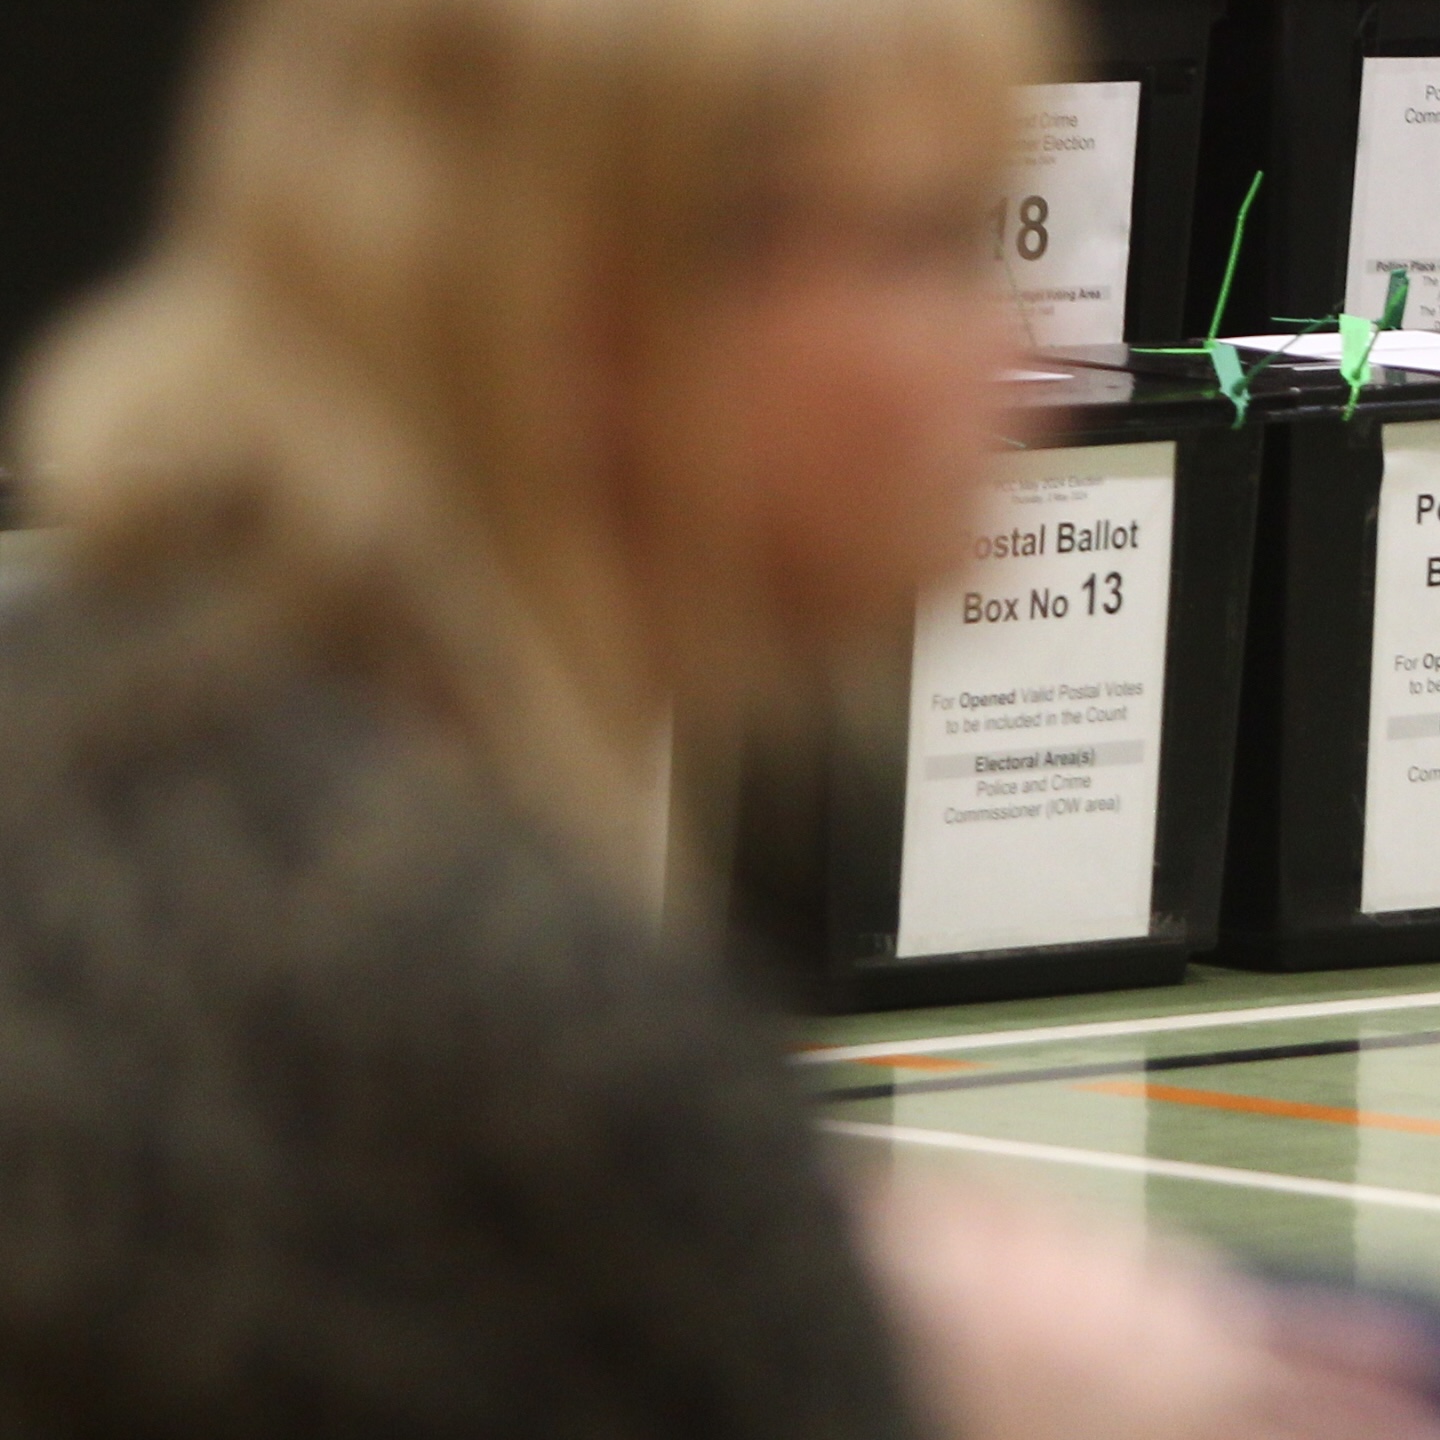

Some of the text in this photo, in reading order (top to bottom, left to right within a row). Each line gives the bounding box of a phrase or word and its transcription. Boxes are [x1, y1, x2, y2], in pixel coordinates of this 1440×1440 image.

[974, 519, 1139, 559] ostal Ballot
[963, 571, 1123, 624] Box No 13
[1394, 655, 1419, 672] For
[959, 691, 1016, 710] Opened
[1021, 687, 1054, 704] Valid
[1058, 684, 1100, 700] Postal
[1105, 681, 1143, 697] Votes
[1409, 680, 1422, 694] to
[946, 706, 1128, 734] to be included in the Count
[975, 748, 1095, 772] Electoral Area(s)
[976, 774, 1092, 797] Police and Crime
